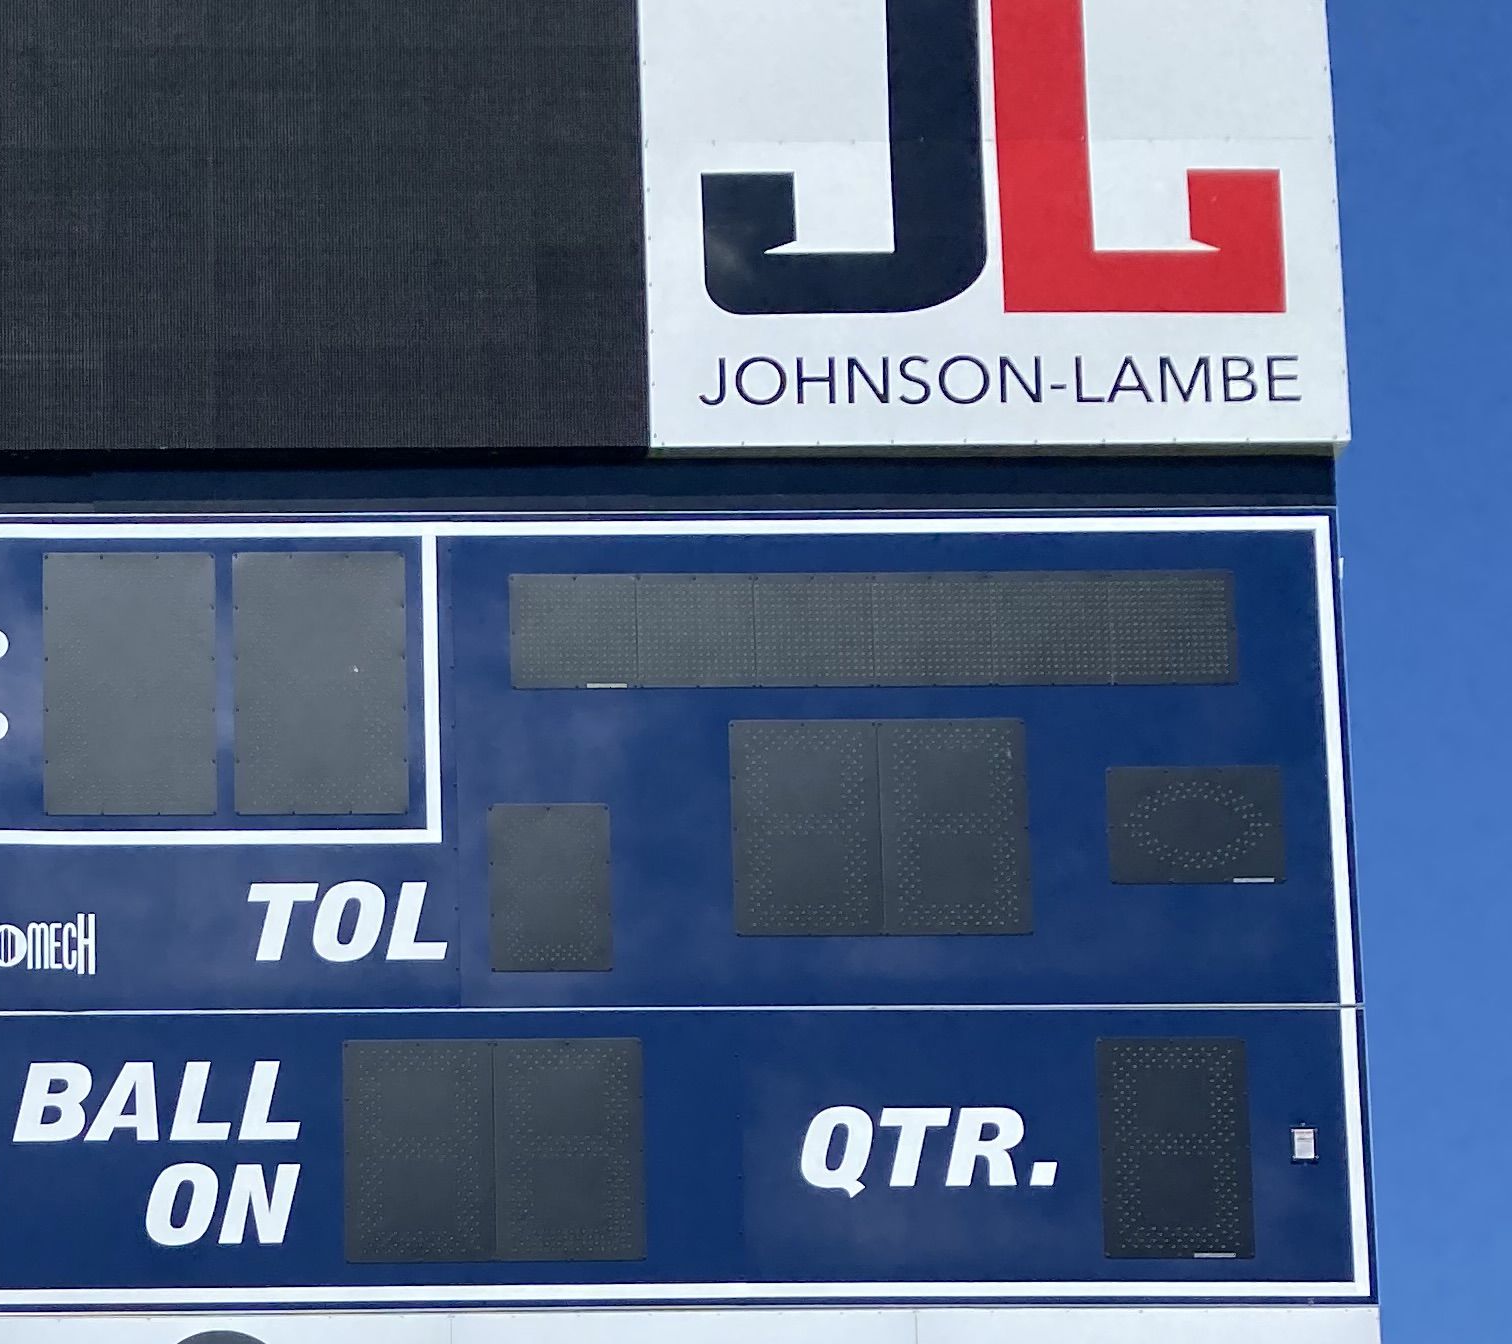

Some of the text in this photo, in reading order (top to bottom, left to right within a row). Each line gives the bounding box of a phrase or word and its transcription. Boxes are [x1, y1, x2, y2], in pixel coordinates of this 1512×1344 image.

[699, 355, 1302, 406] JOHNSON-LAMBE
[247, 880, 448, 962] TOL
[12, 1060, 302, 1143] BALL
[800, 1105, 1058, 1198] QTR.
[145, 1163, 301, 1246] ON
